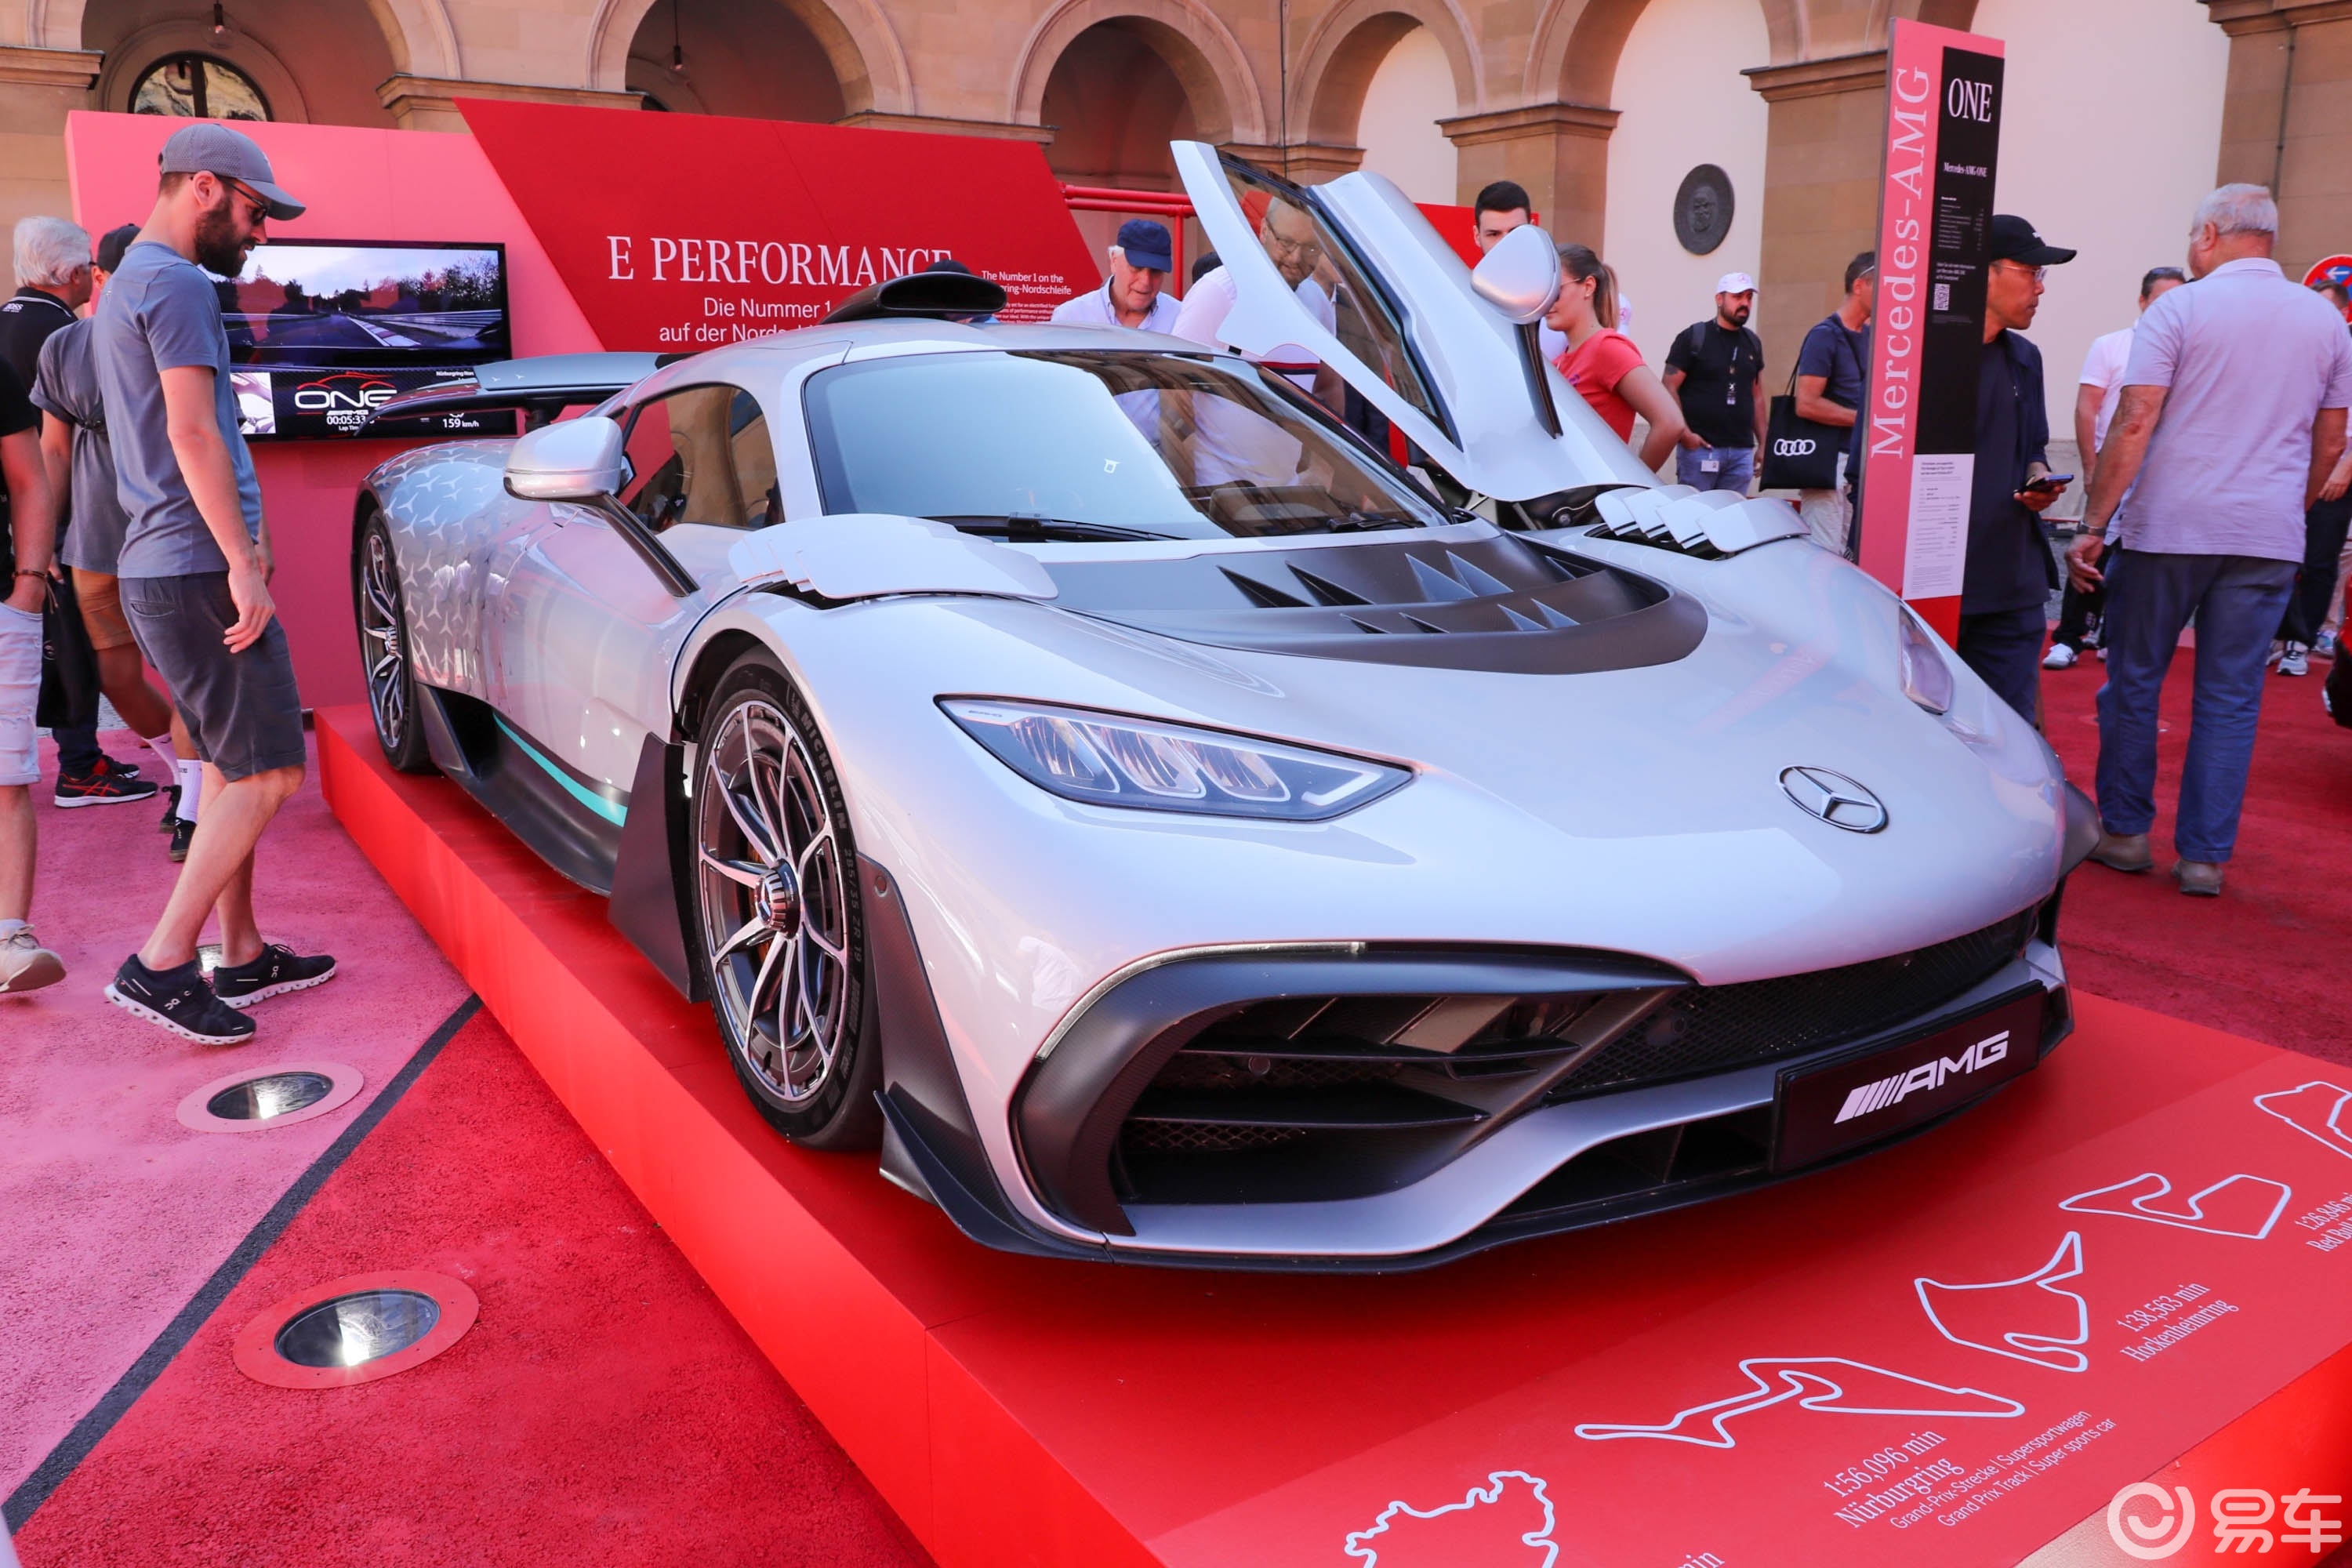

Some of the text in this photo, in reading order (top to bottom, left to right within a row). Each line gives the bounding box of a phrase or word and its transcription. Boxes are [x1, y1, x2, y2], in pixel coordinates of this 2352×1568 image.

[1948, 78, 1992, 123] ONE
[607, 236, 952, 287] E PERFORMANC
[982, 270, 997, 281] The
[999, 271, 1032, 281] Number
[1033, 273, 1036, 282] 1
[1050, 274, 1064, 283] the
[1871, 66, 1929, 459] Mercedes-AMG
[704, 297, 831, 318] Die Nummer 1
[1000, 283, 1072, 295] ring-Nordschleife
[659, 322, 690, 342] auf
[695, 323, 727, 342] der
[295, 390, 397, 408] ONE
[442, 419, 461, 428] 159
[800, 712, 847, 829] MICHELIN
[1889, 1030, 2010, 1103] AMG
[2306, 1233, 2344, 1252] Red
[2117, 1283, 2211, 1332] 1:38,563 min
[2119, 1299, 2240, 1362] Hockenheimring
[1824, 1431, 1947, 1497] 1:56,096 min
[1890, 1461, 2000, 1530] Grand-Prix-Strecke
[1997, 1410, 2092, 1465] Supersportwagen
[1937, 1500, 1981, 1527] Grand
[1972, 1486, 2004, 1512] Prix
[1998, 1468, 2034, 1492] Track
[2029, 1448, 2068, 1472] Super
[2063, 1428, 2101, 1451] sports
[2096, 1417, 2117, 1432] car
[1833, 1457, 1965, 1528] Nürburgring
[1678, 1551, 1726, 1568] in
